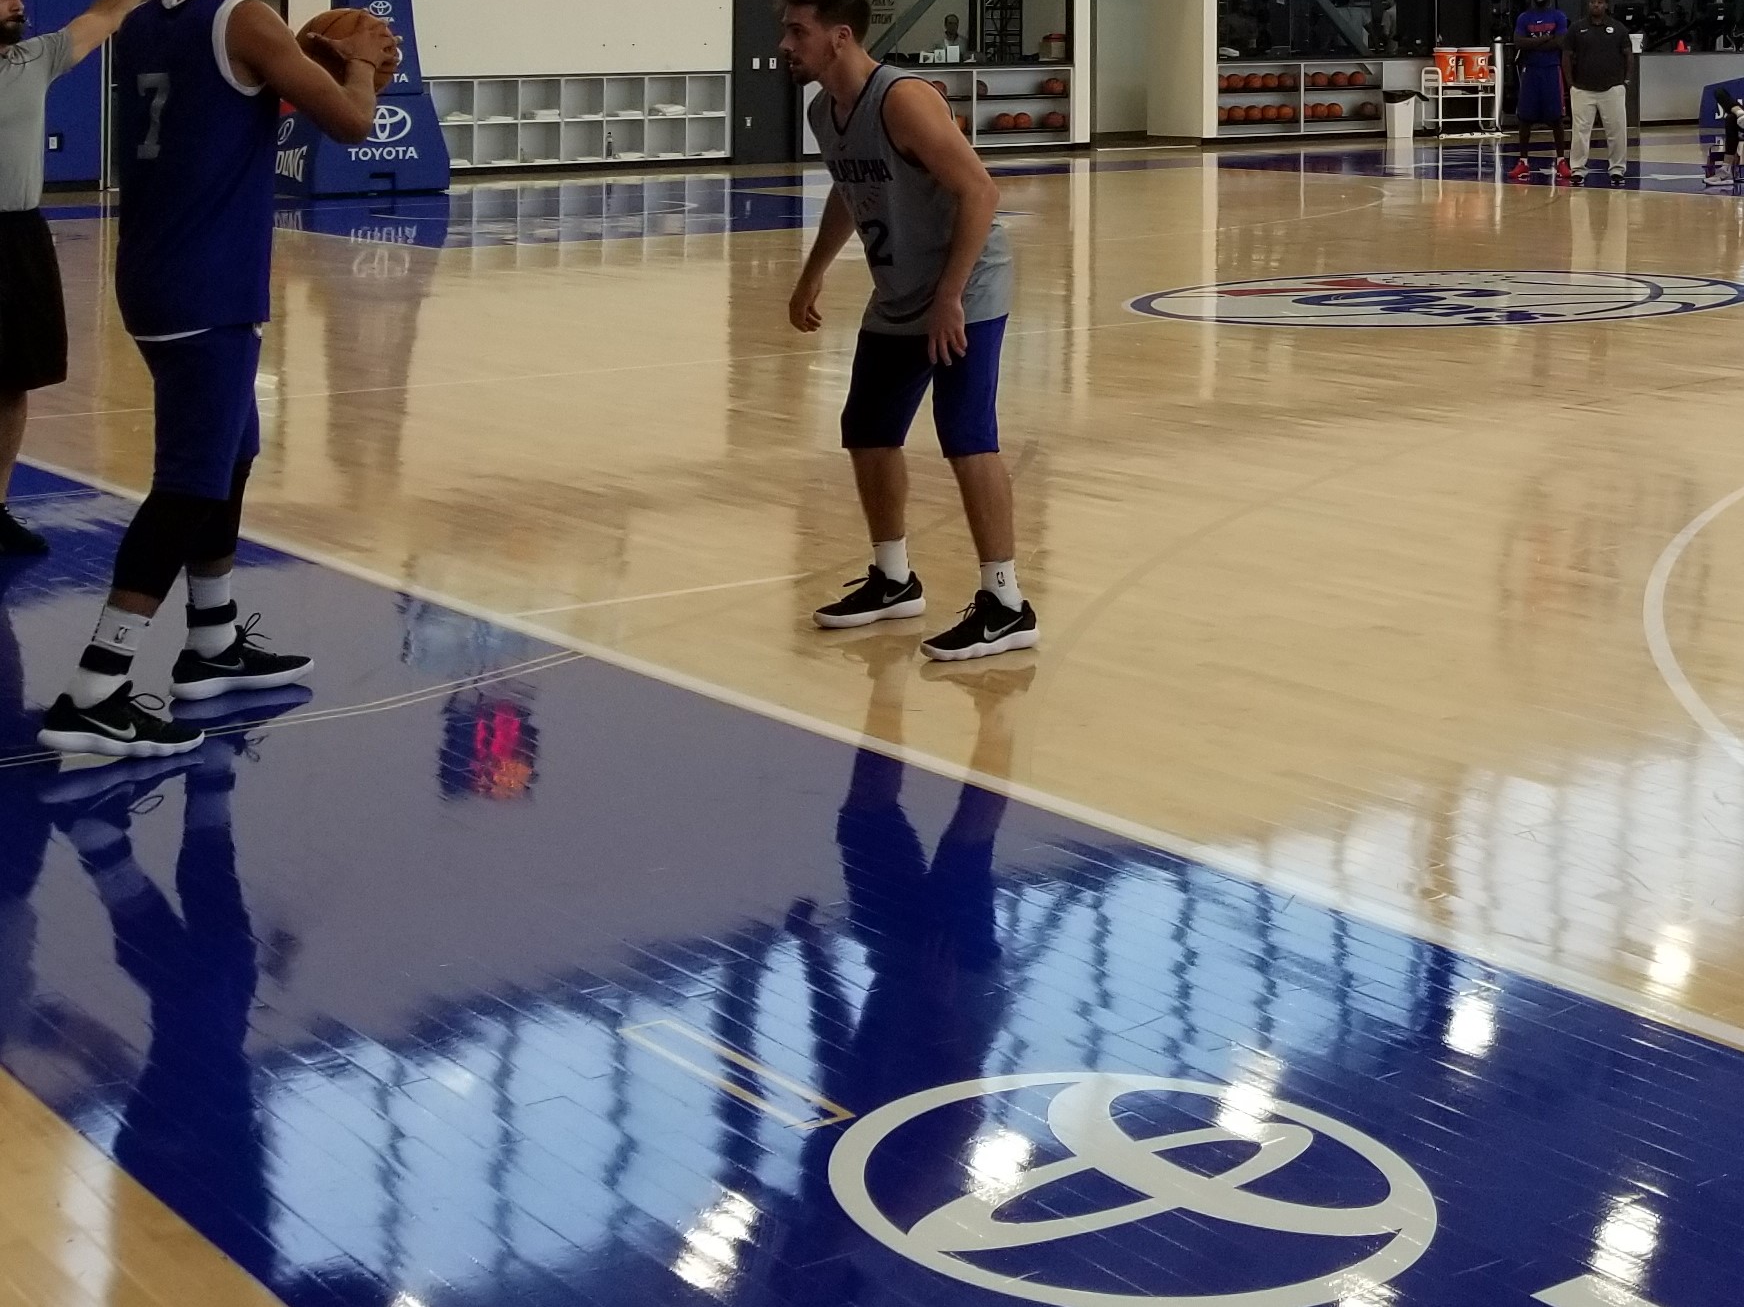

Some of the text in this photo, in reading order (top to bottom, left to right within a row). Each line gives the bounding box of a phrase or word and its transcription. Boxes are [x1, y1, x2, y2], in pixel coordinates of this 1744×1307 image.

[137, 73, 170, 159] 7
[275, 145, 307, 182] DING
[348, 146, 418, 161] TOYOTA
[861, 220, 893, 267] 2
